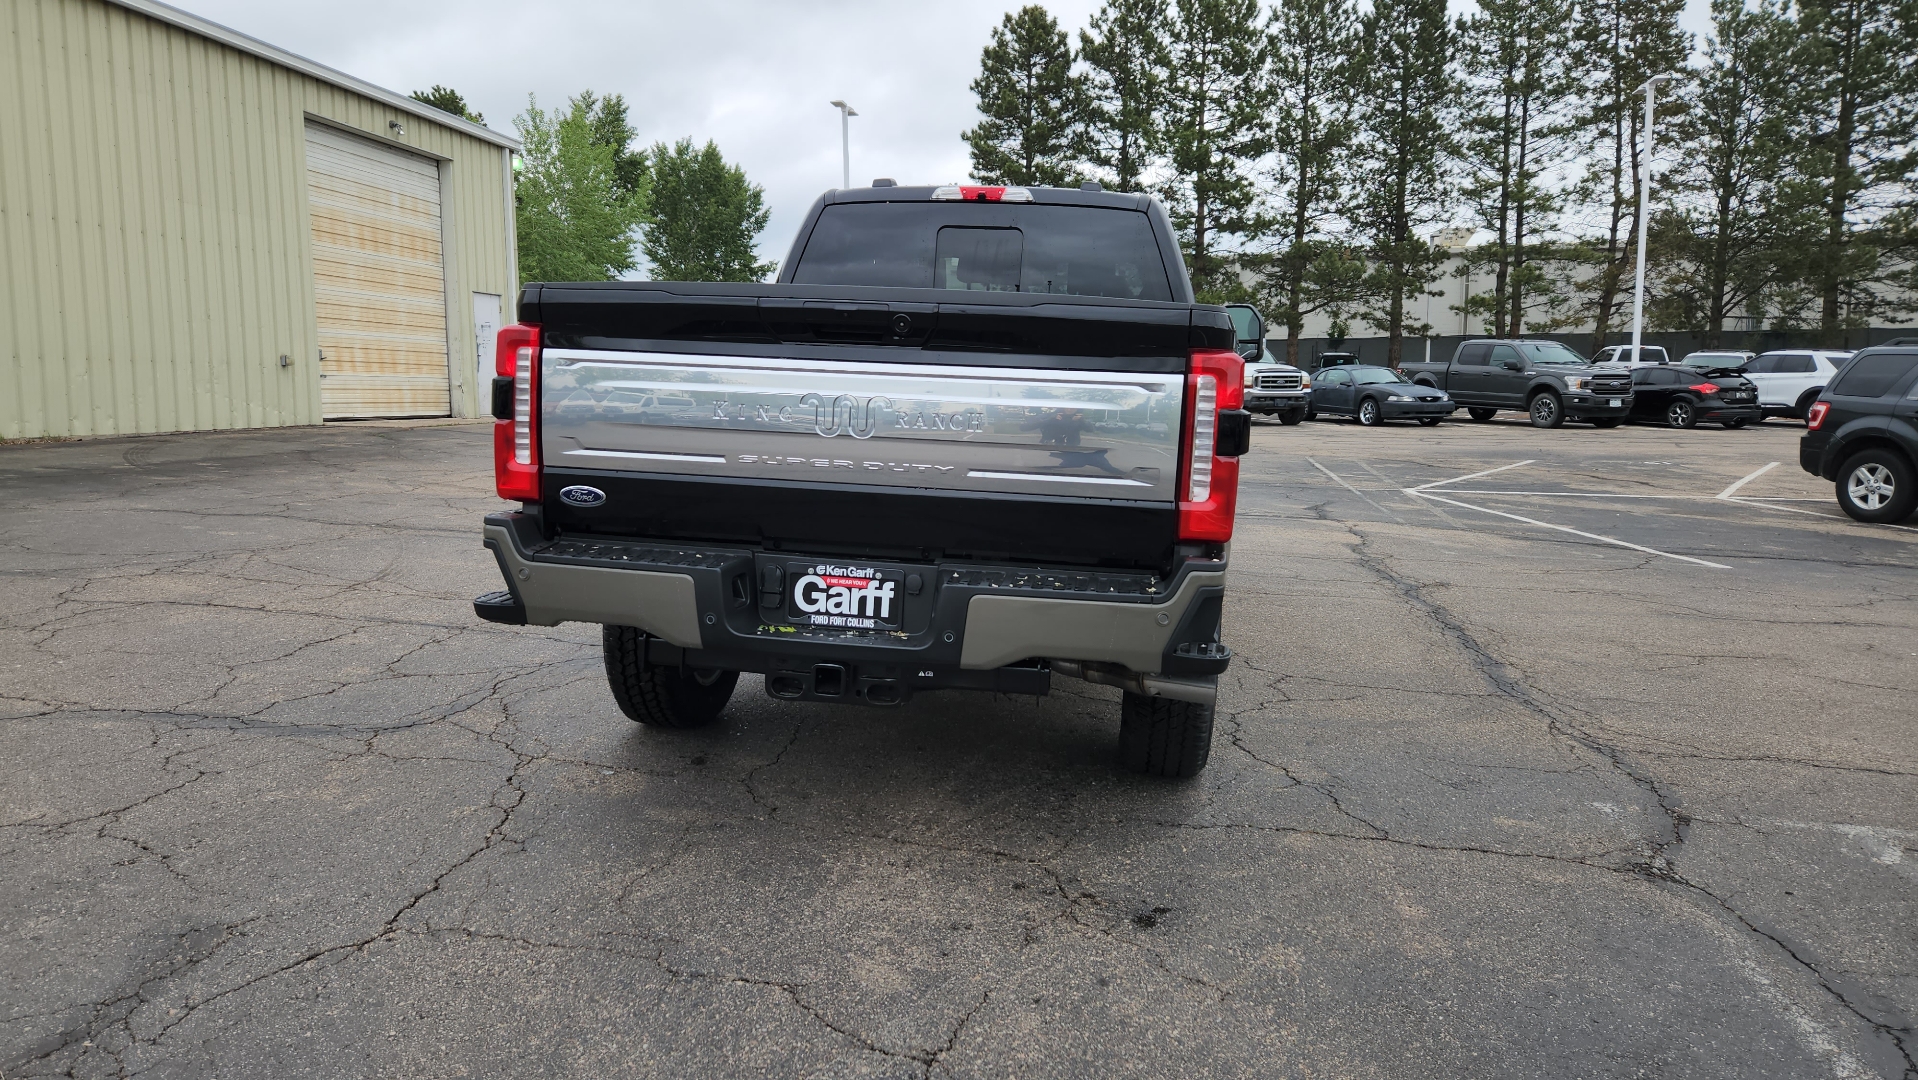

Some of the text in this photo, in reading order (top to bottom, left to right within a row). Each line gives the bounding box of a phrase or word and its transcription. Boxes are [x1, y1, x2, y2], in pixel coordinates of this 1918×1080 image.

[712, 399, 984, 433] KING RANCH
[737, 454, 955, 474] SUPER DUTY
[570, 489, 595, 502] Ford
[826, 565, 874, 578] Ken Garff
[794, 575, 895, 618] Garff
[811, 615, 874, 628] FORD FORT COLLINS
